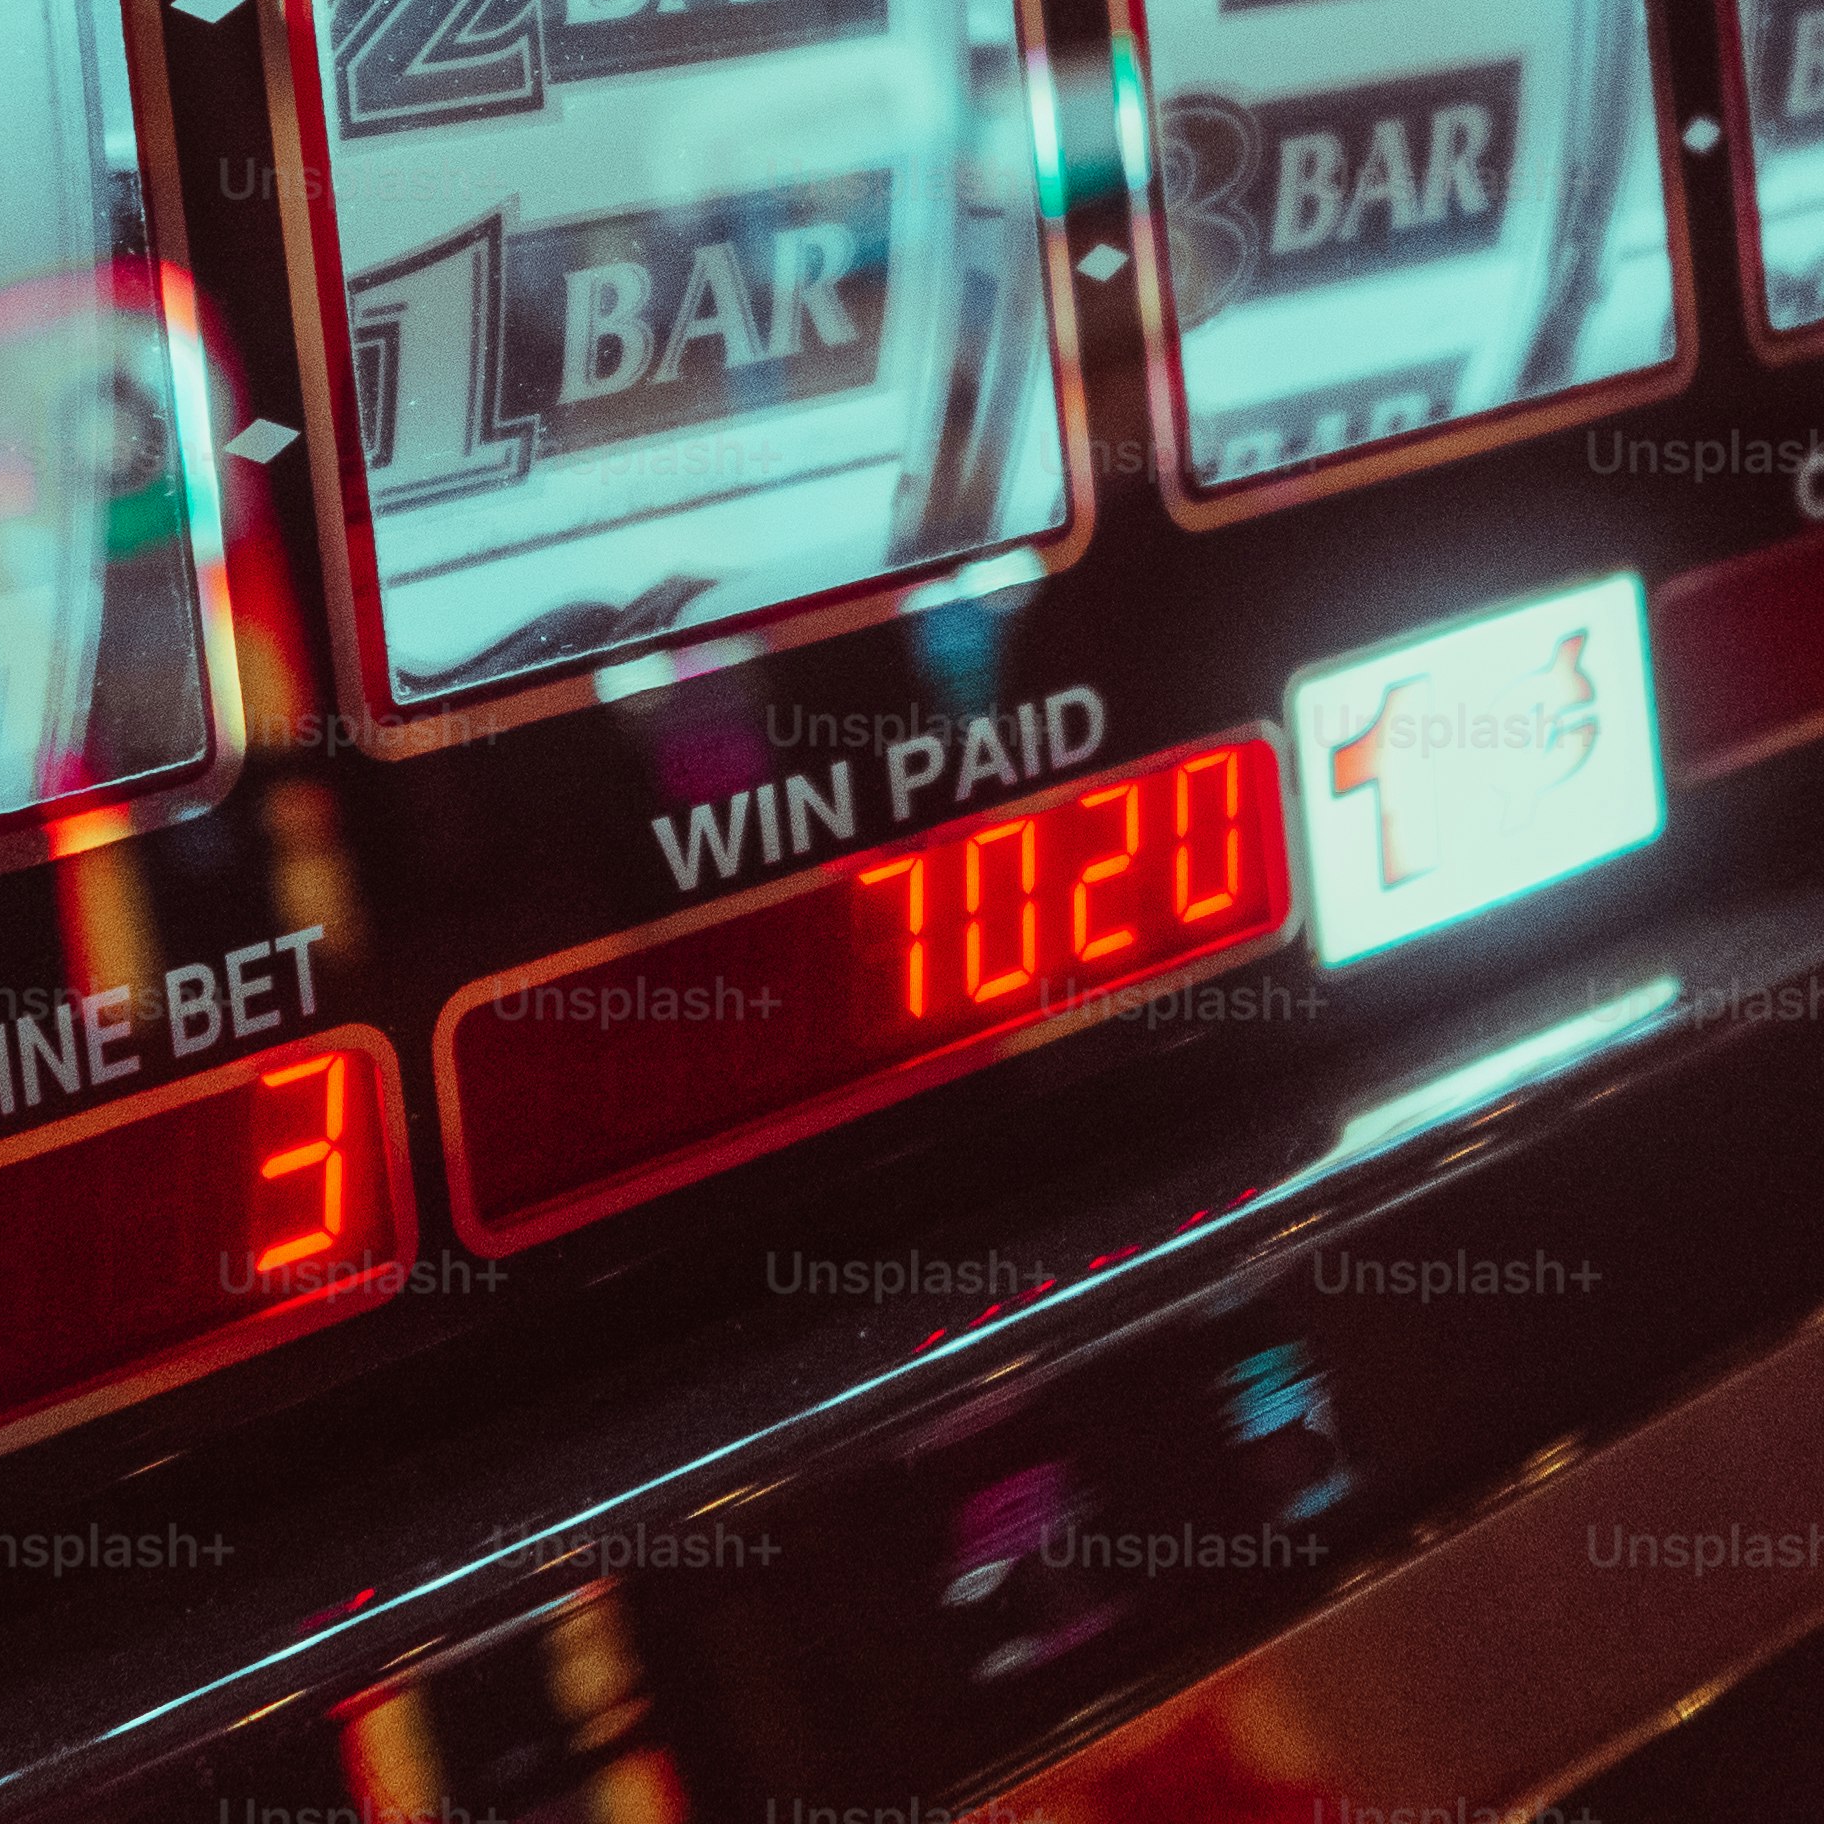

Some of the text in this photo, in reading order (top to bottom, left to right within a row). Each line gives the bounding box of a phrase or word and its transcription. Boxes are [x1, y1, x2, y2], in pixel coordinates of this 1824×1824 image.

[1269, 102, 1496, 257] BAR
[346, 210, 860, 518] 1 BAR
[650, 683, 1109, 893] WIN PAID
[857, 746, 1242, 1022] 7020
[163, 923, 326, 1059] BET
[253, 1052, 348, 1275] 3
